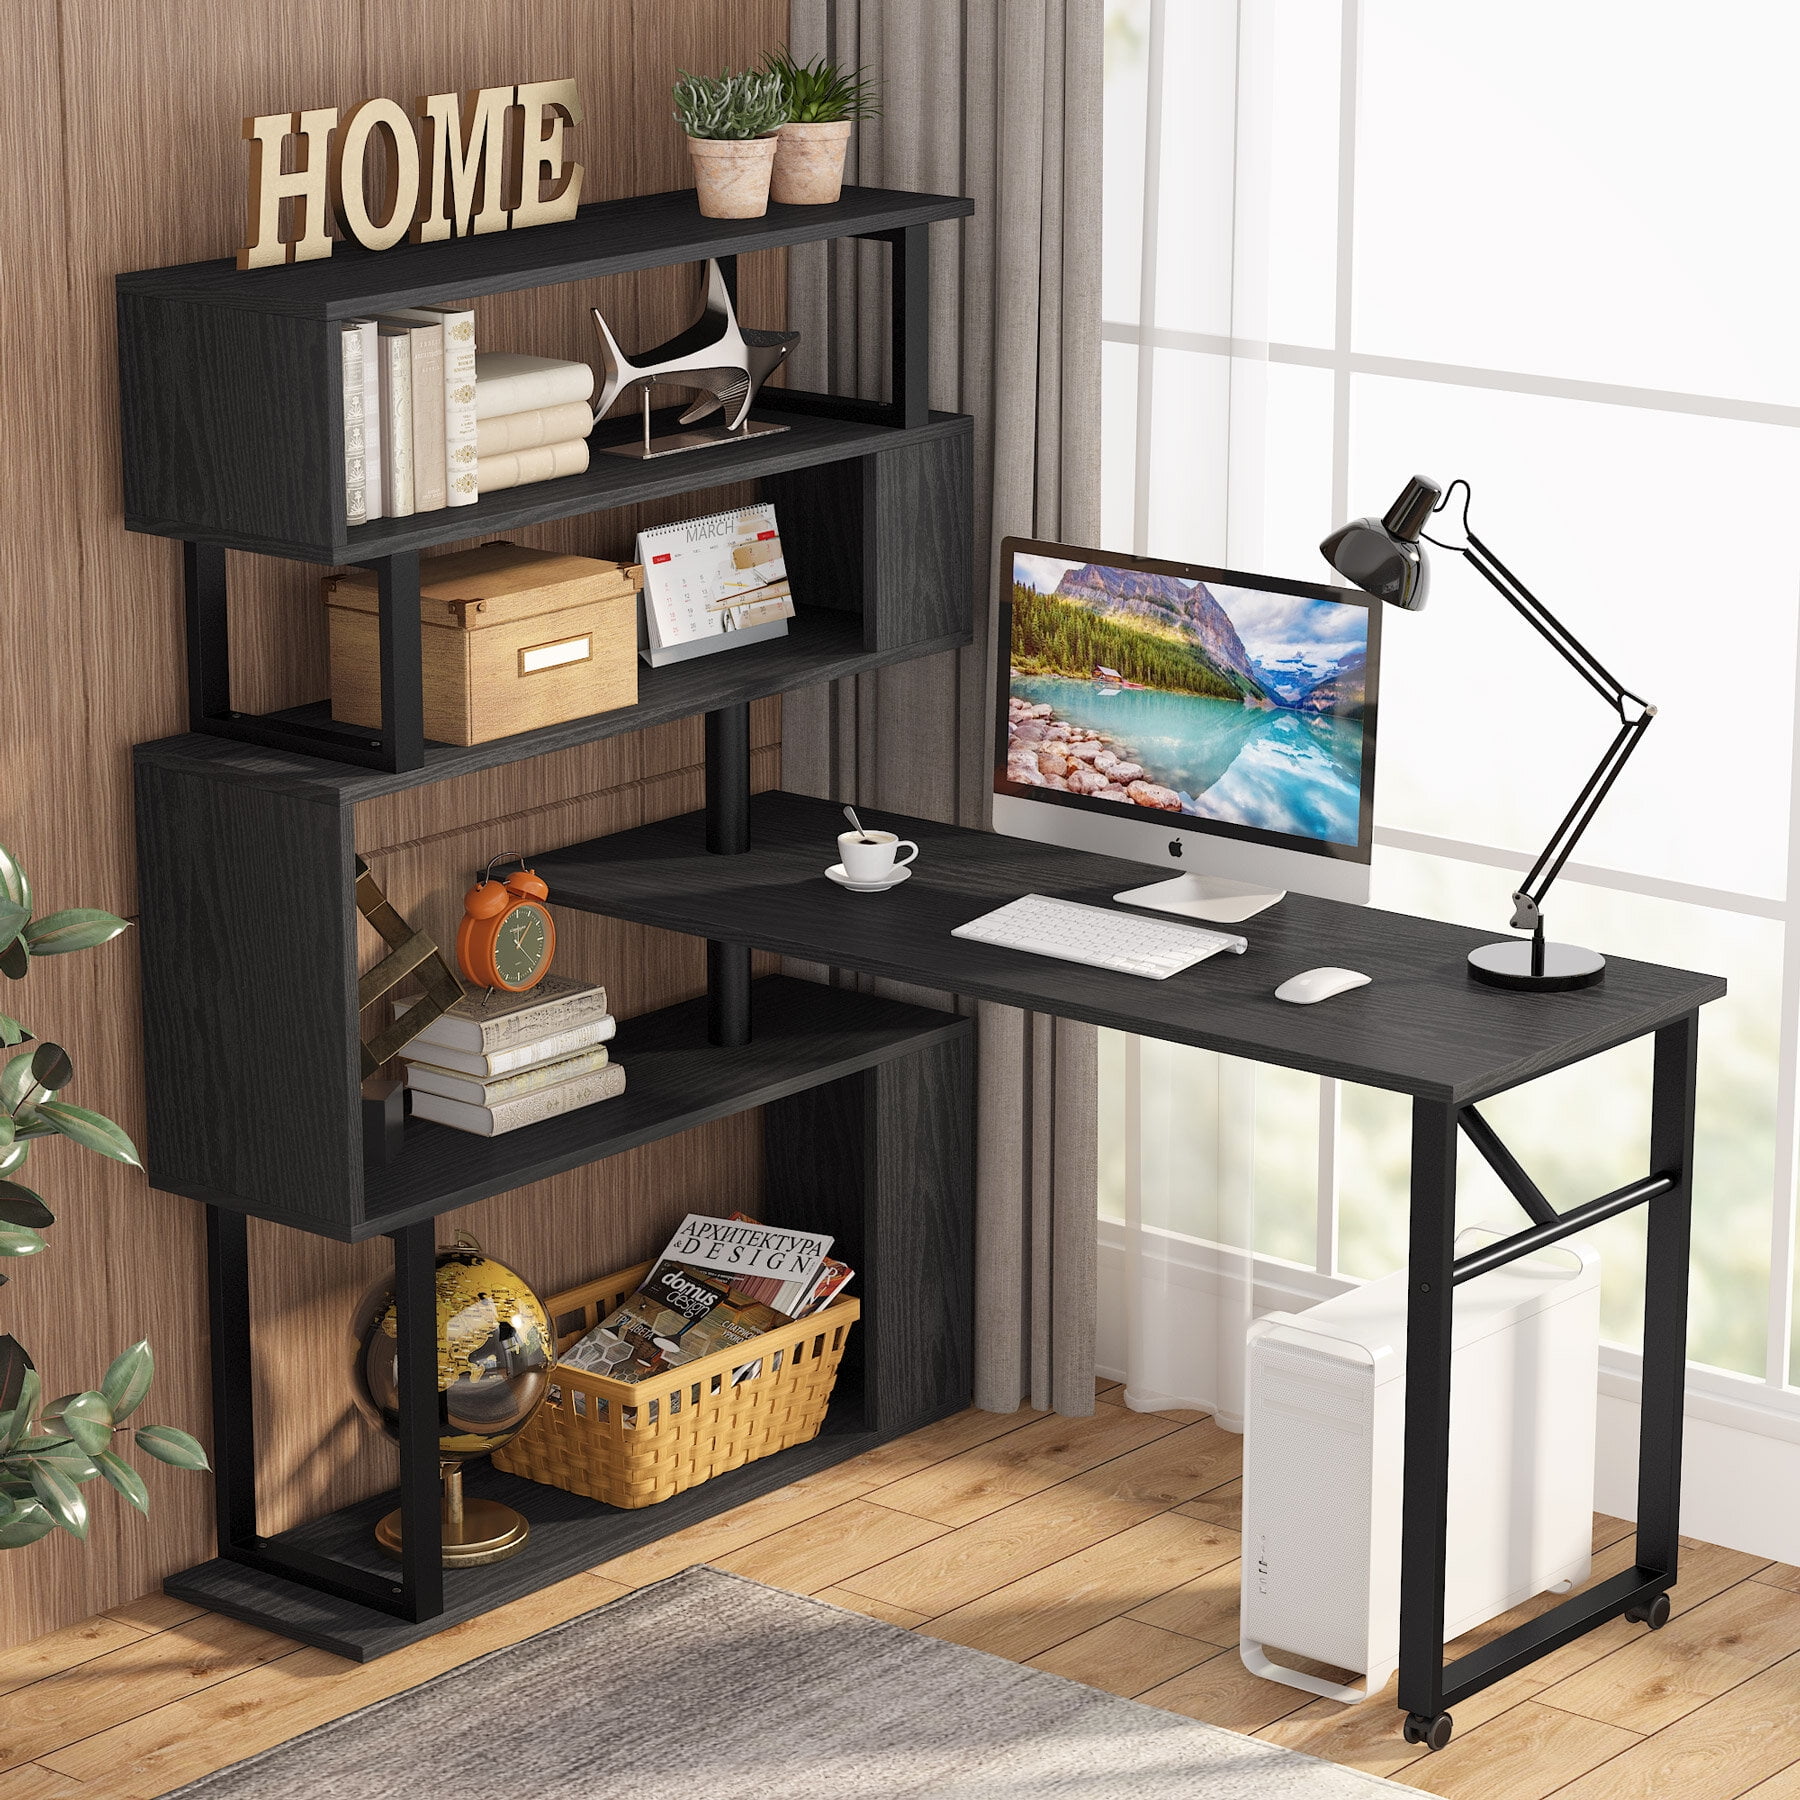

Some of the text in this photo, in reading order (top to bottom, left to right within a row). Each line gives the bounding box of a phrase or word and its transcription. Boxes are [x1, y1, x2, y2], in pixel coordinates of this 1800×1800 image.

[236, 78, 585, 271] HOME
[686, 520, 734, 543] MARCH
[673, 1240, 682, 1248] &
[680, 1237, 812, 1274] DESIGN
[681, 1221, 823, 1257] АРХИТЕКТУРА
[661, 1271, 719, 1306] domus
[666, 1291, 710, 1319] design
